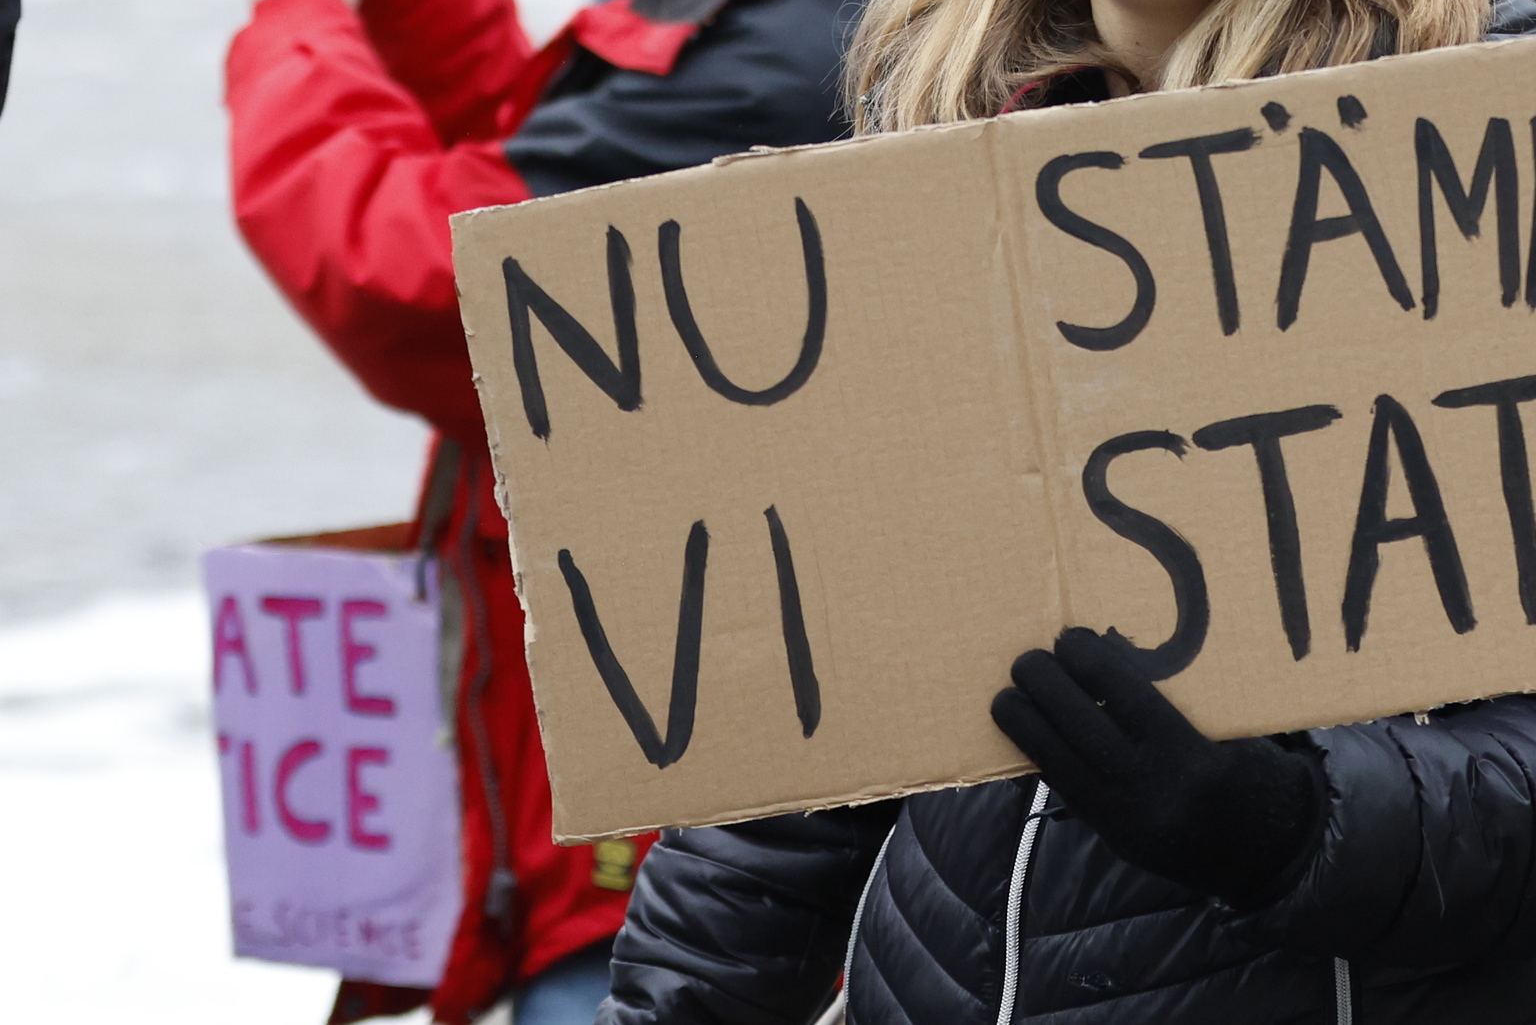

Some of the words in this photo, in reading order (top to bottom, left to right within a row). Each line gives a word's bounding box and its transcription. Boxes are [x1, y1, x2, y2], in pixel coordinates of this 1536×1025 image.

[503, 196, 828, 442] NU
[558, 504, 821, 770] VI
[215, 732, 393, 851] ICE
